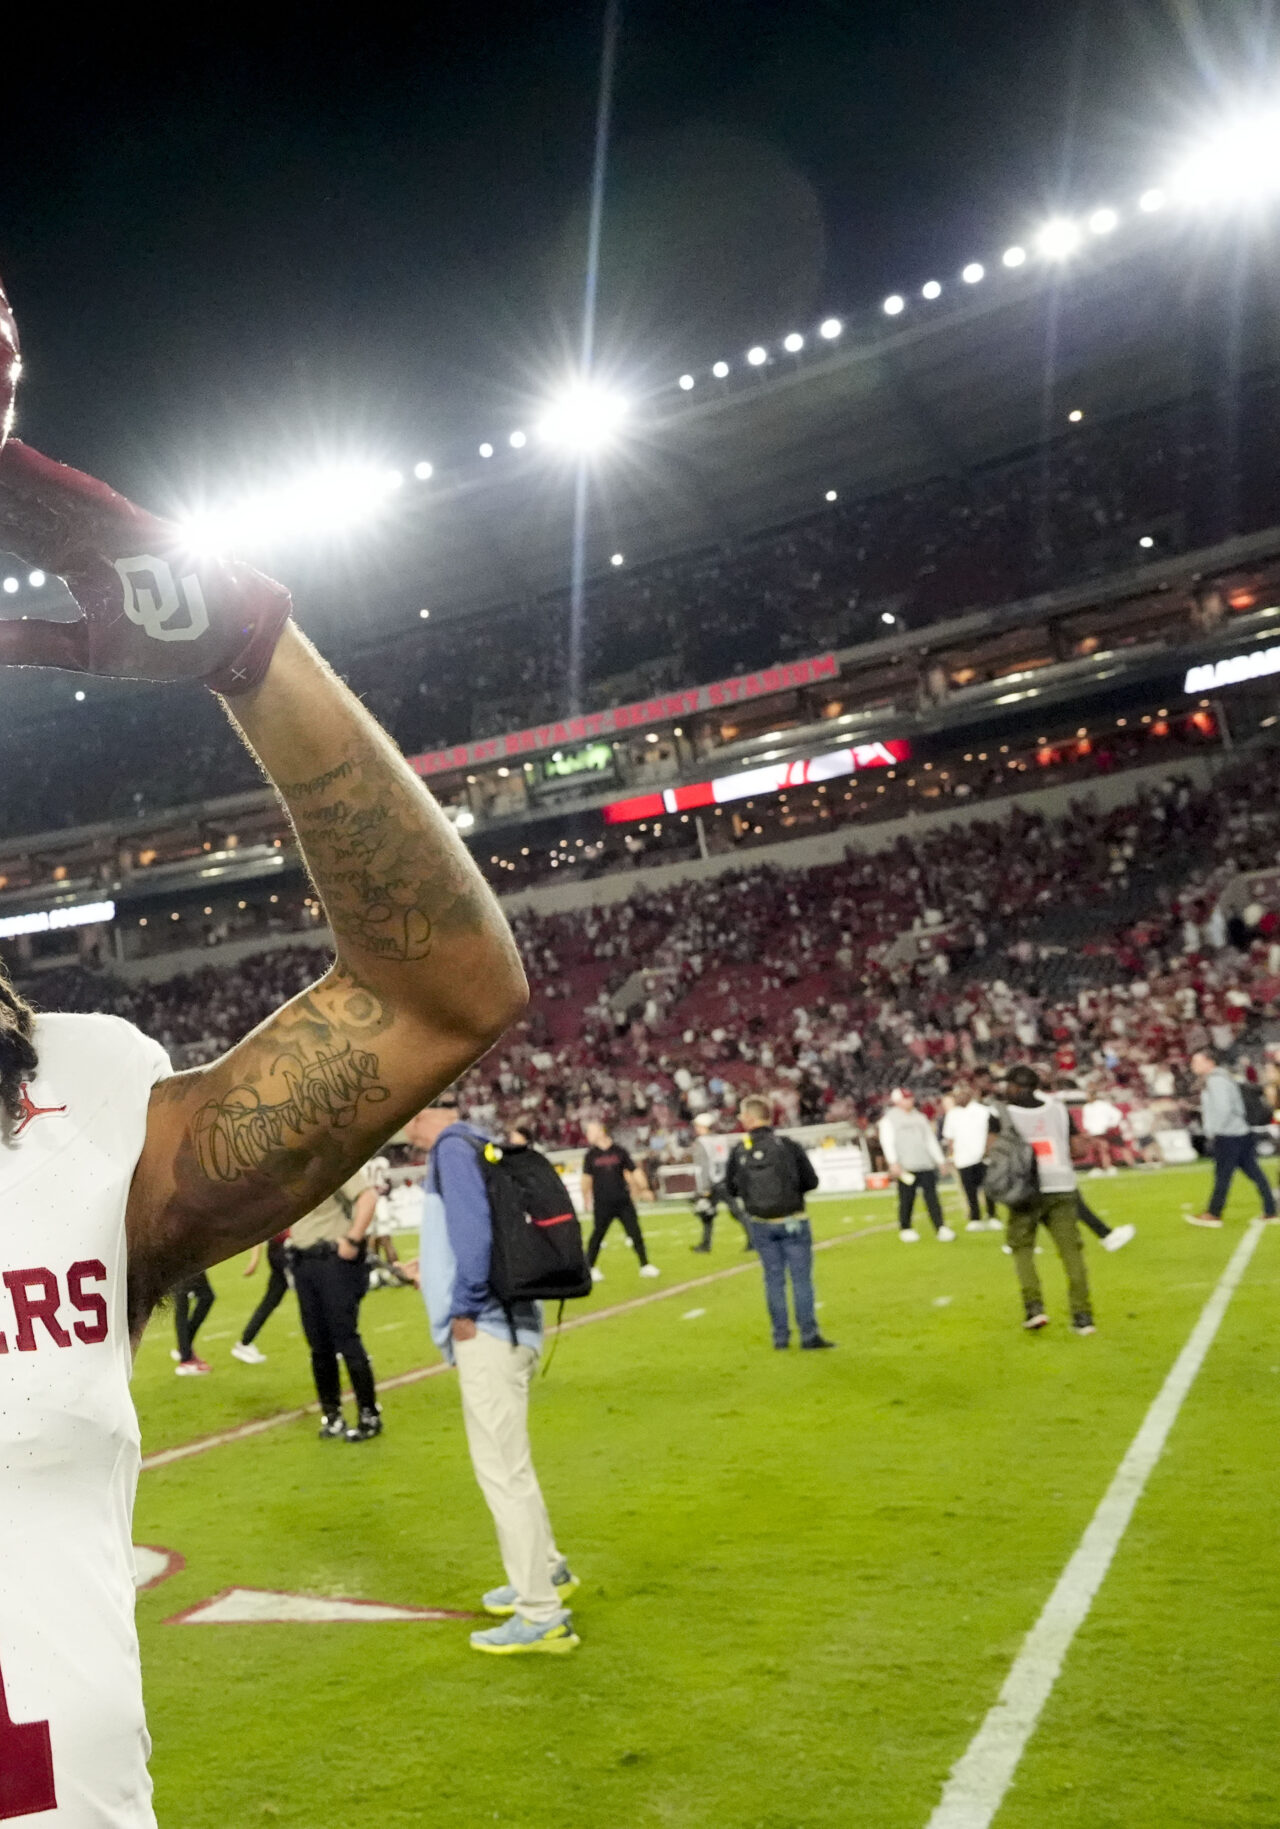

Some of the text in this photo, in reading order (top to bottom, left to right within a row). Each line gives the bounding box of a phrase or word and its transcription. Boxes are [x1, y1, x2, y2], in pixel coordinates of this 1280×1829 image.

[115, 554, 210, 641] OU
[504, 690, 700, 756] BRYANT-DENNY
[708, 654, 837, 706] STADIUM
